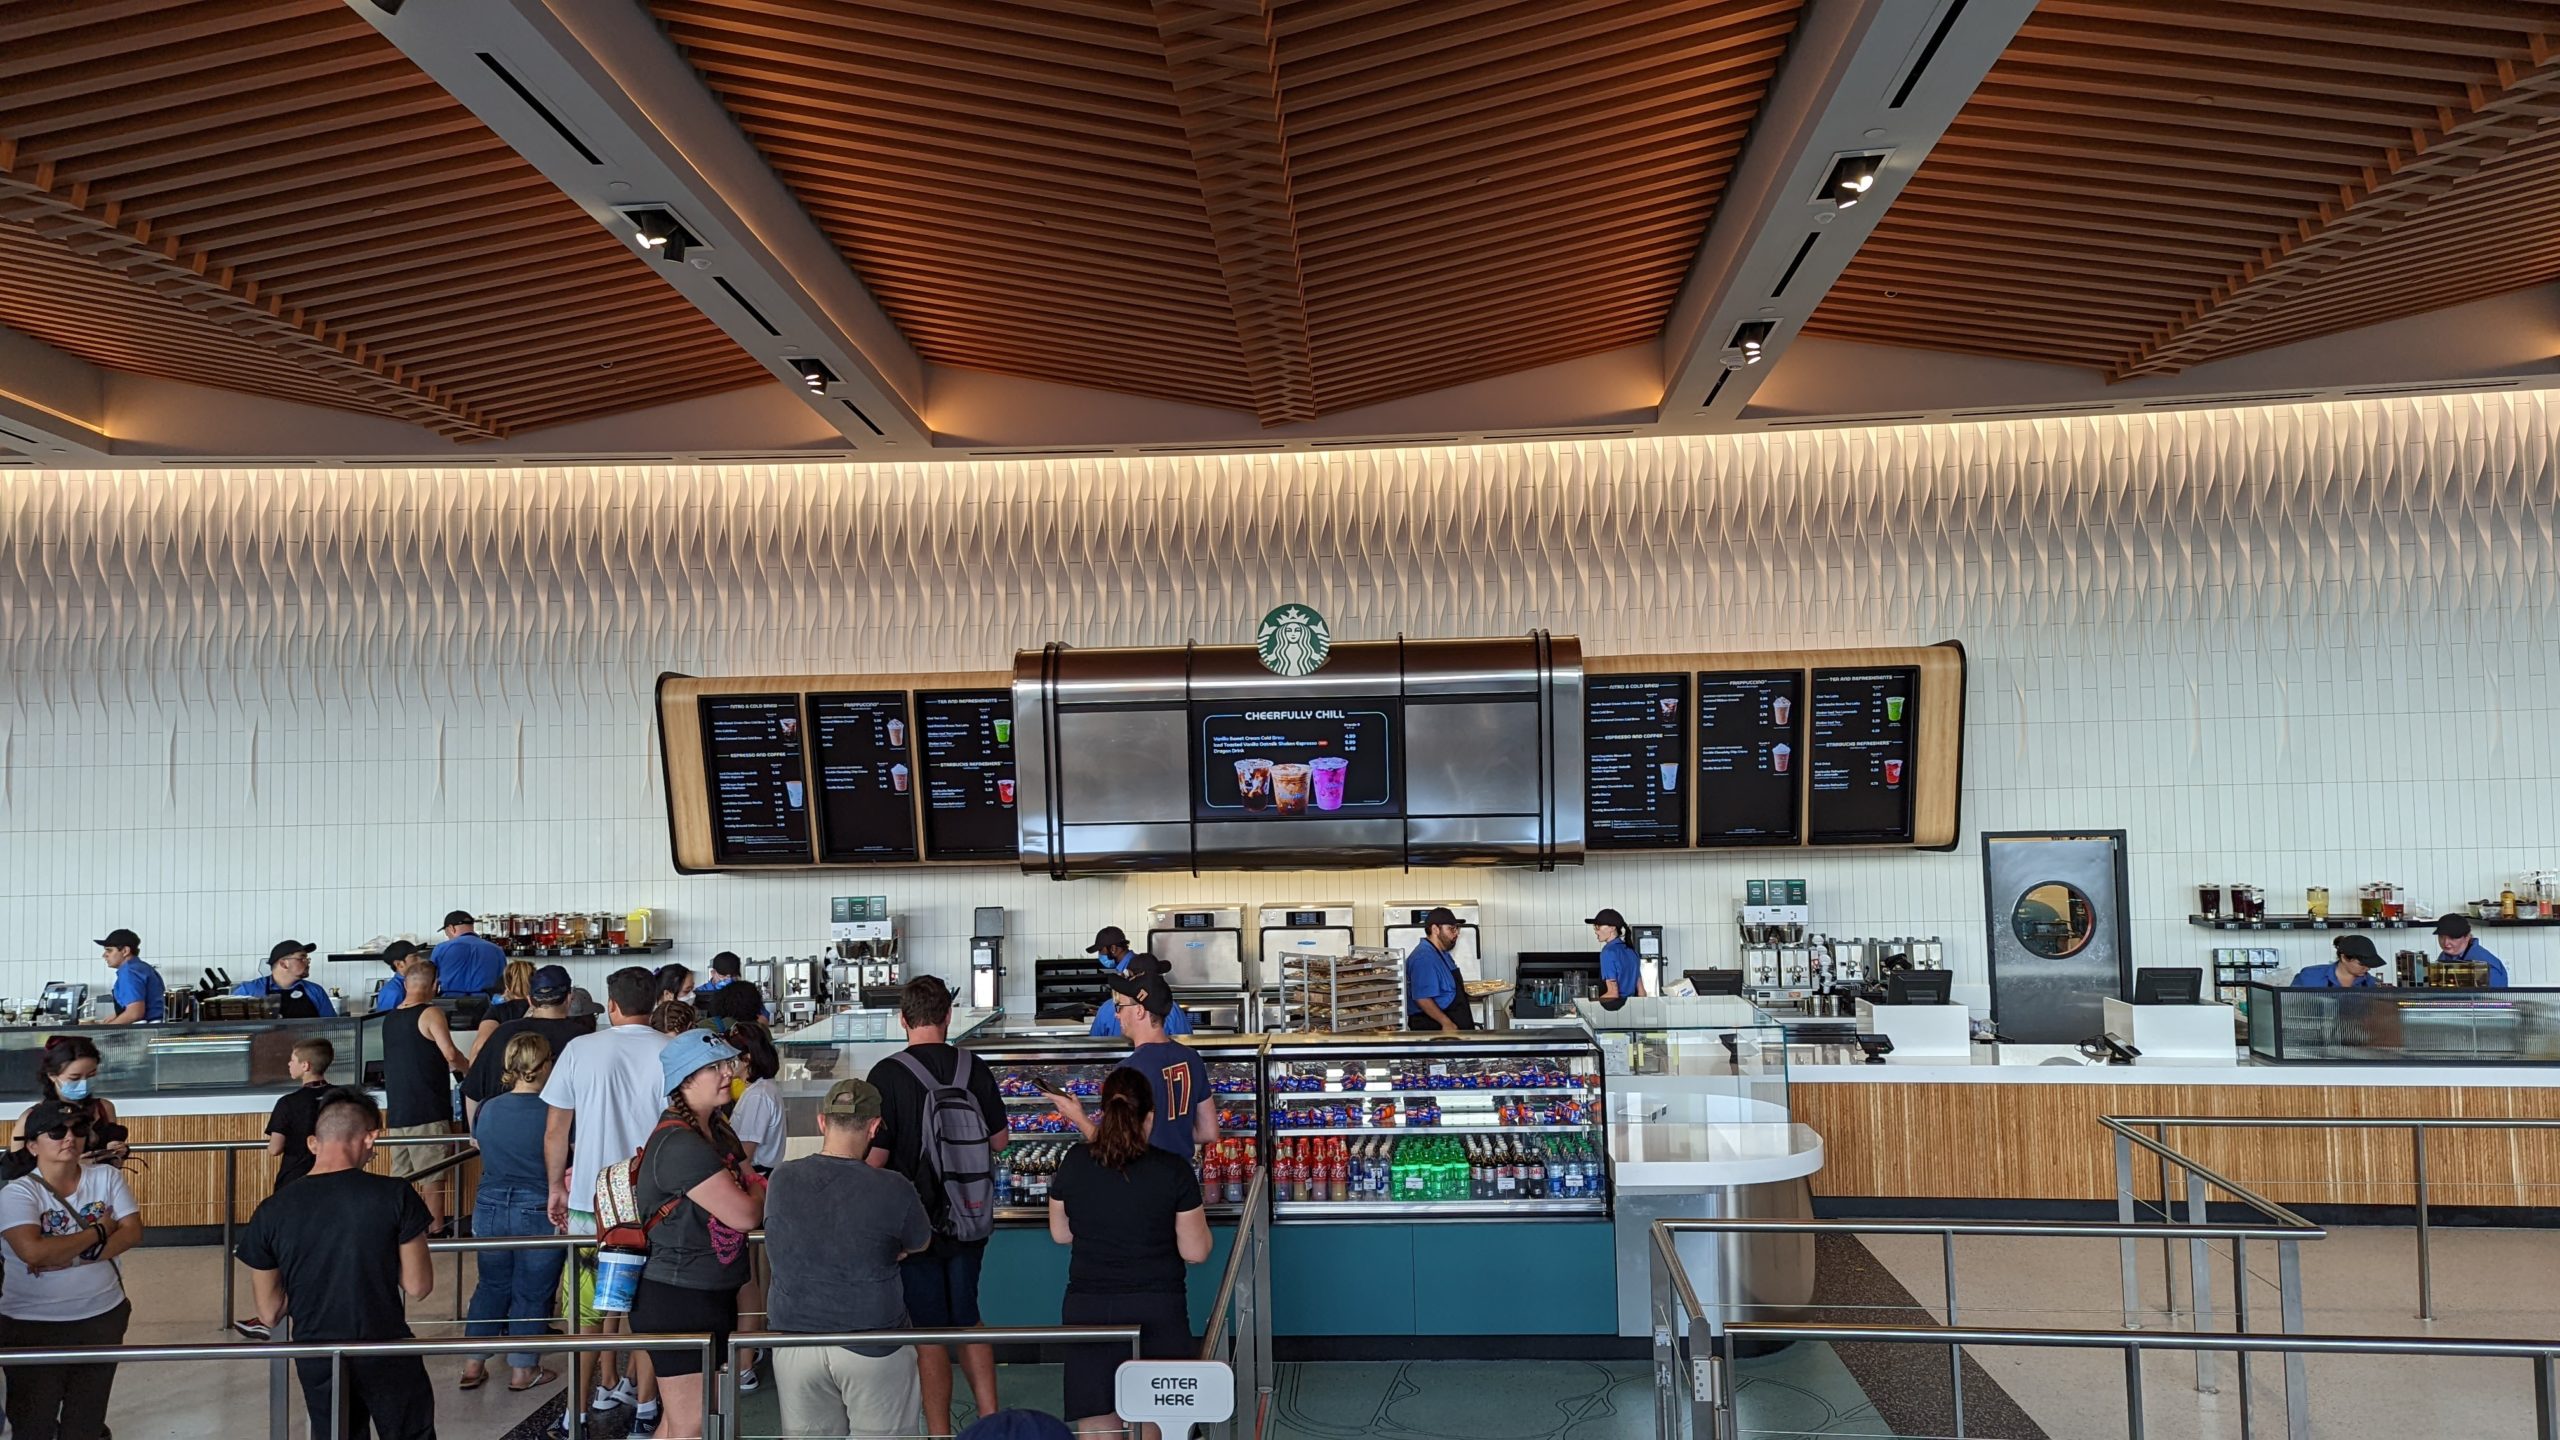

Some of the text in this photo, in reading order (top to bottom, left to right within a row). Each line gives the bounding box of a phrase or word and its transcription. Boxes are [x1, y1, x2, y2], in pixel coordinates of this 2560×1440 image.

[1245, 710, 1345, 720] CHEERFULLY CHILL
[1162, 1062, 1190, 1120] 17
[1151, 1377, 1198, 1389] ENTER
[1154, 1394, 1195, 1406] HERE
